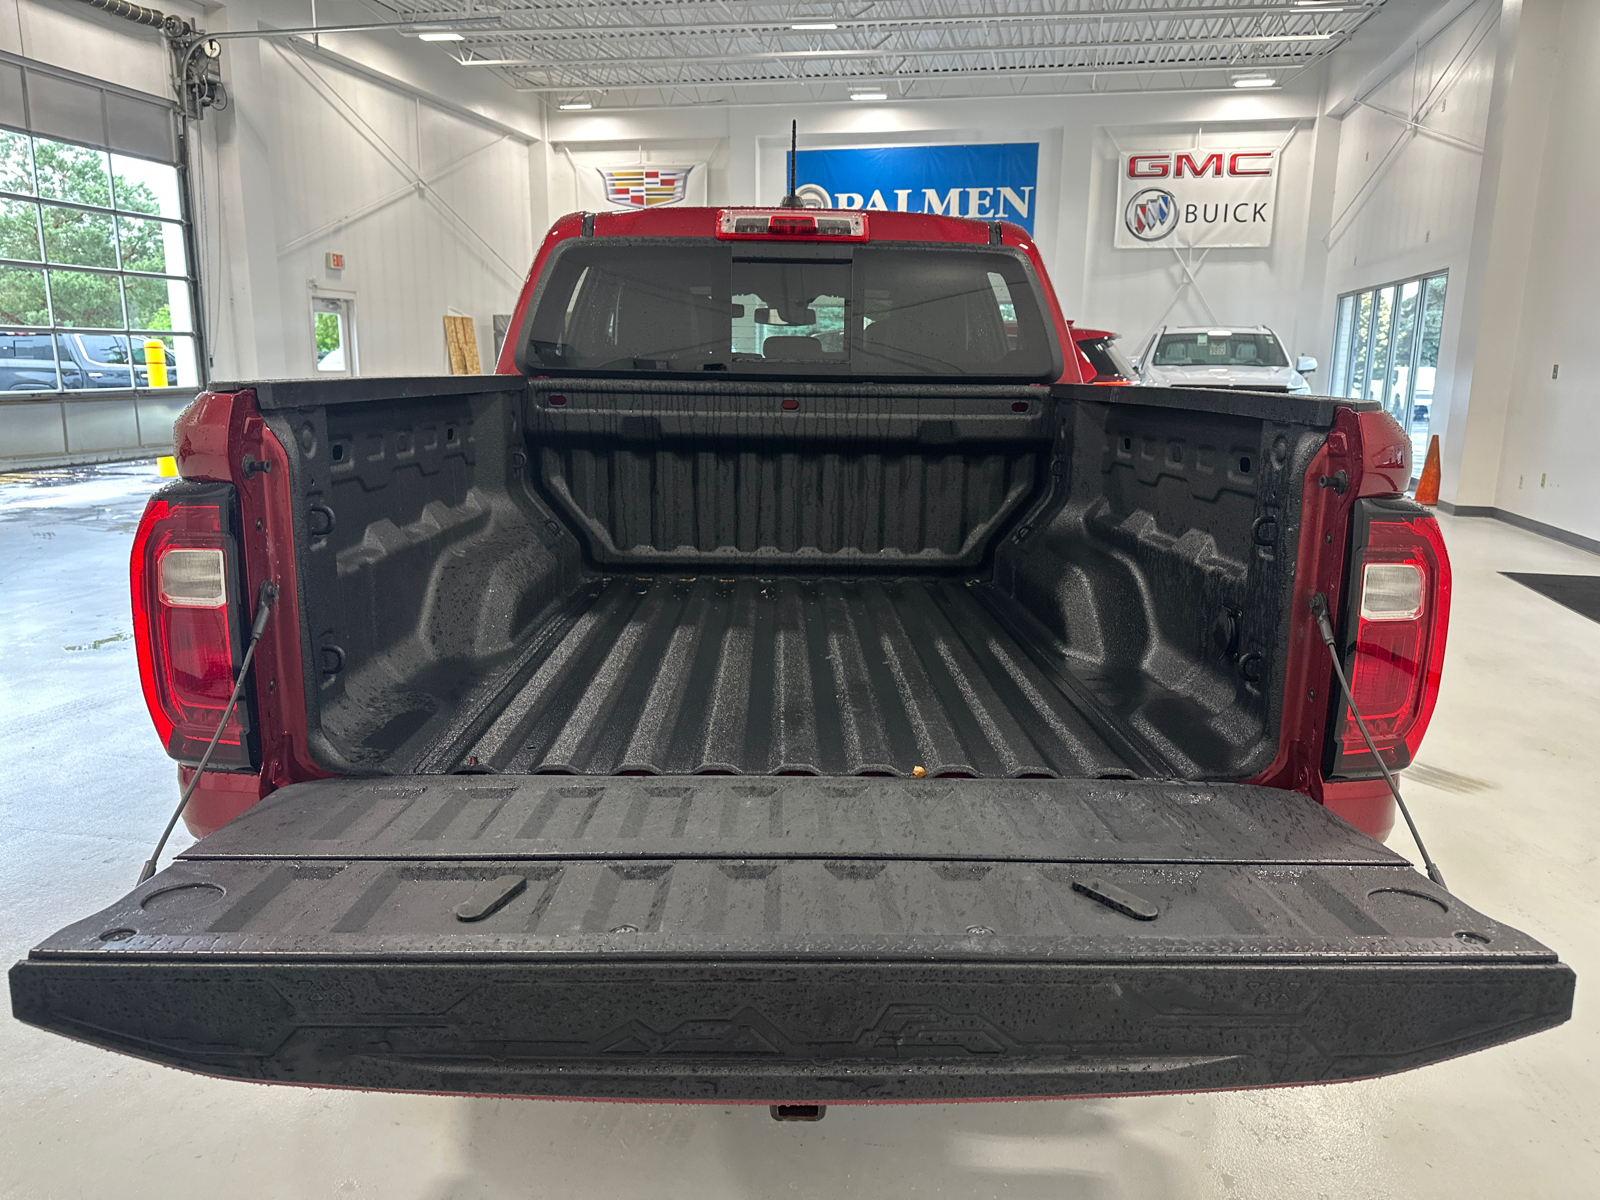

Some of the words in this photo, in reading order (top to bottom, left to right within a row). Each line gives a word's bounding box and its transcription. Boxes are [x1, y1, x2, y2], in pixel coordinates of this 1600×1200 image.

[1127, 151, 1273, 180] GMC
[834, 186, 1034, 219] PALMEN
[1185, 202, 1268, 224] BUICK
